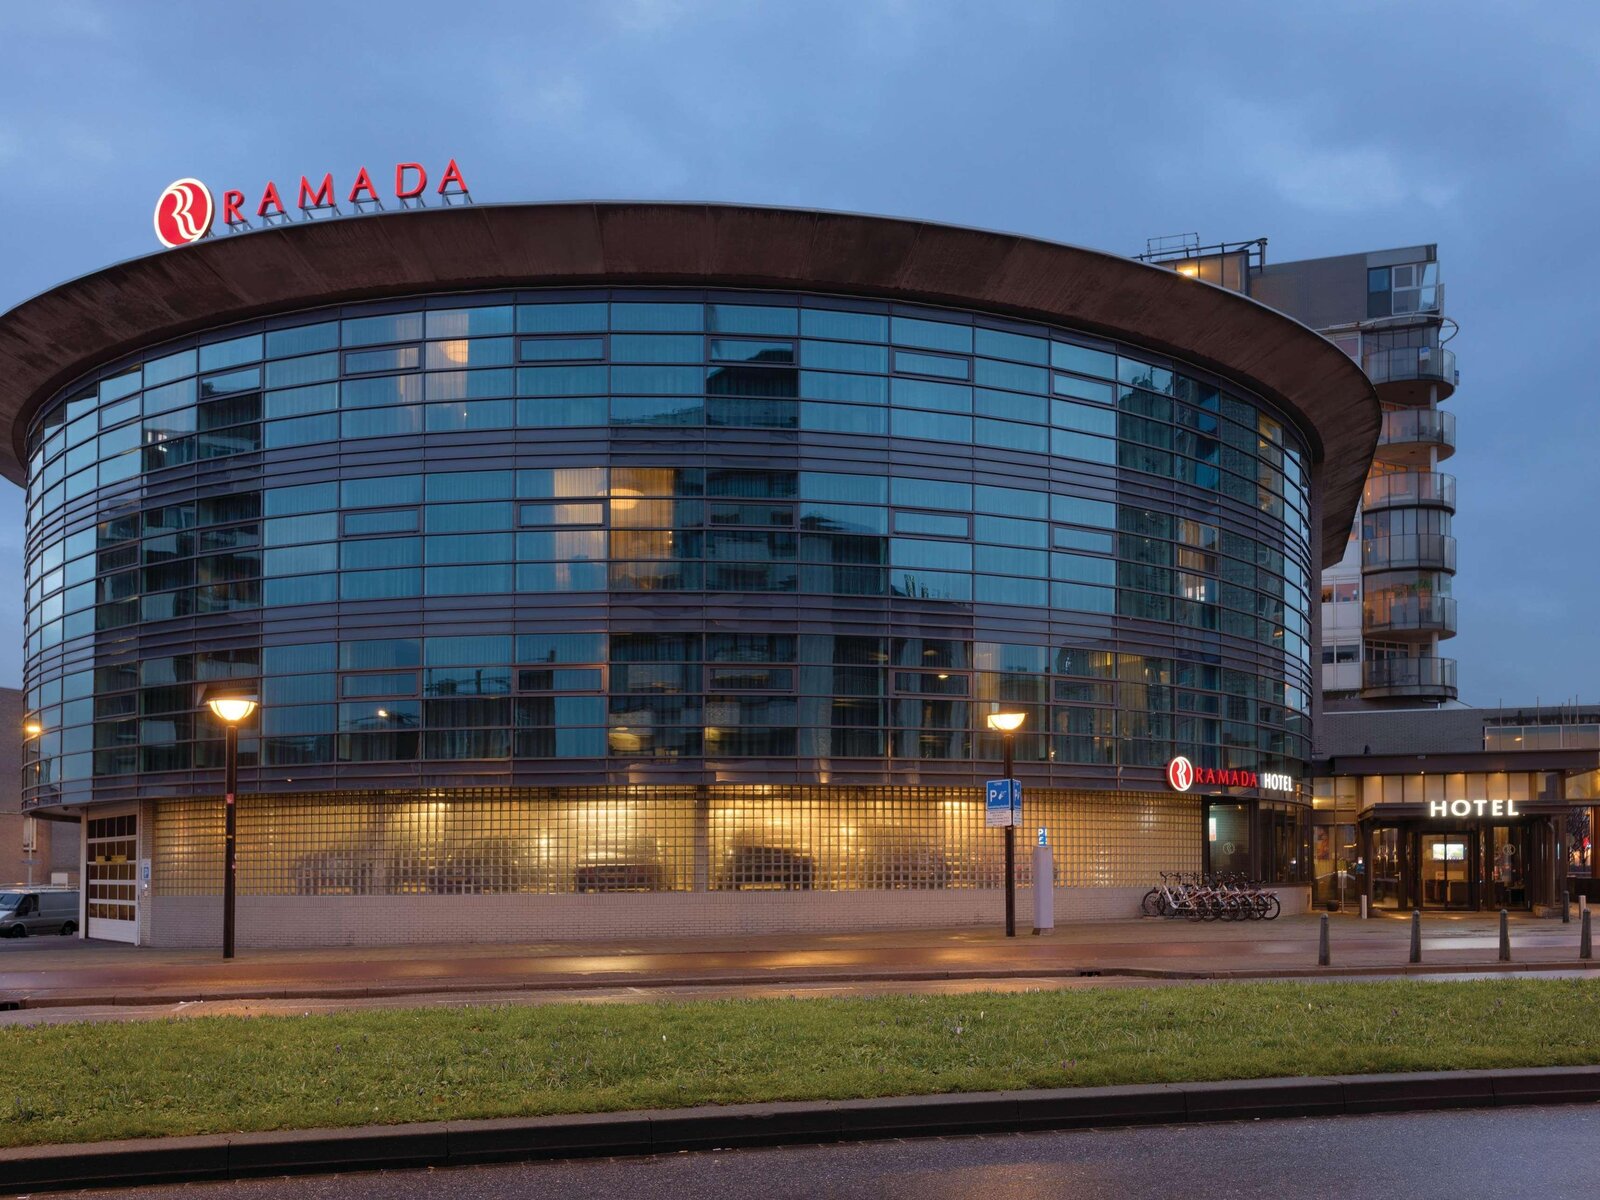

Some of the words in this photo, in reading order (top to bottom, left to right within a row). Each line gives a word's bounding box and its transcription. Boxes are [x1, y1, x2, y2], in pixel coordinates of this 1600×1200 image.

[223, 159, 468, 224] RAMADA
[1195, 767, 1258, 788] RAMADA
[1264, 772, 1293, 792] HOTEL
[990, 790, 997, 802] P
[1430, 799, 1519, 817] HOTEL
